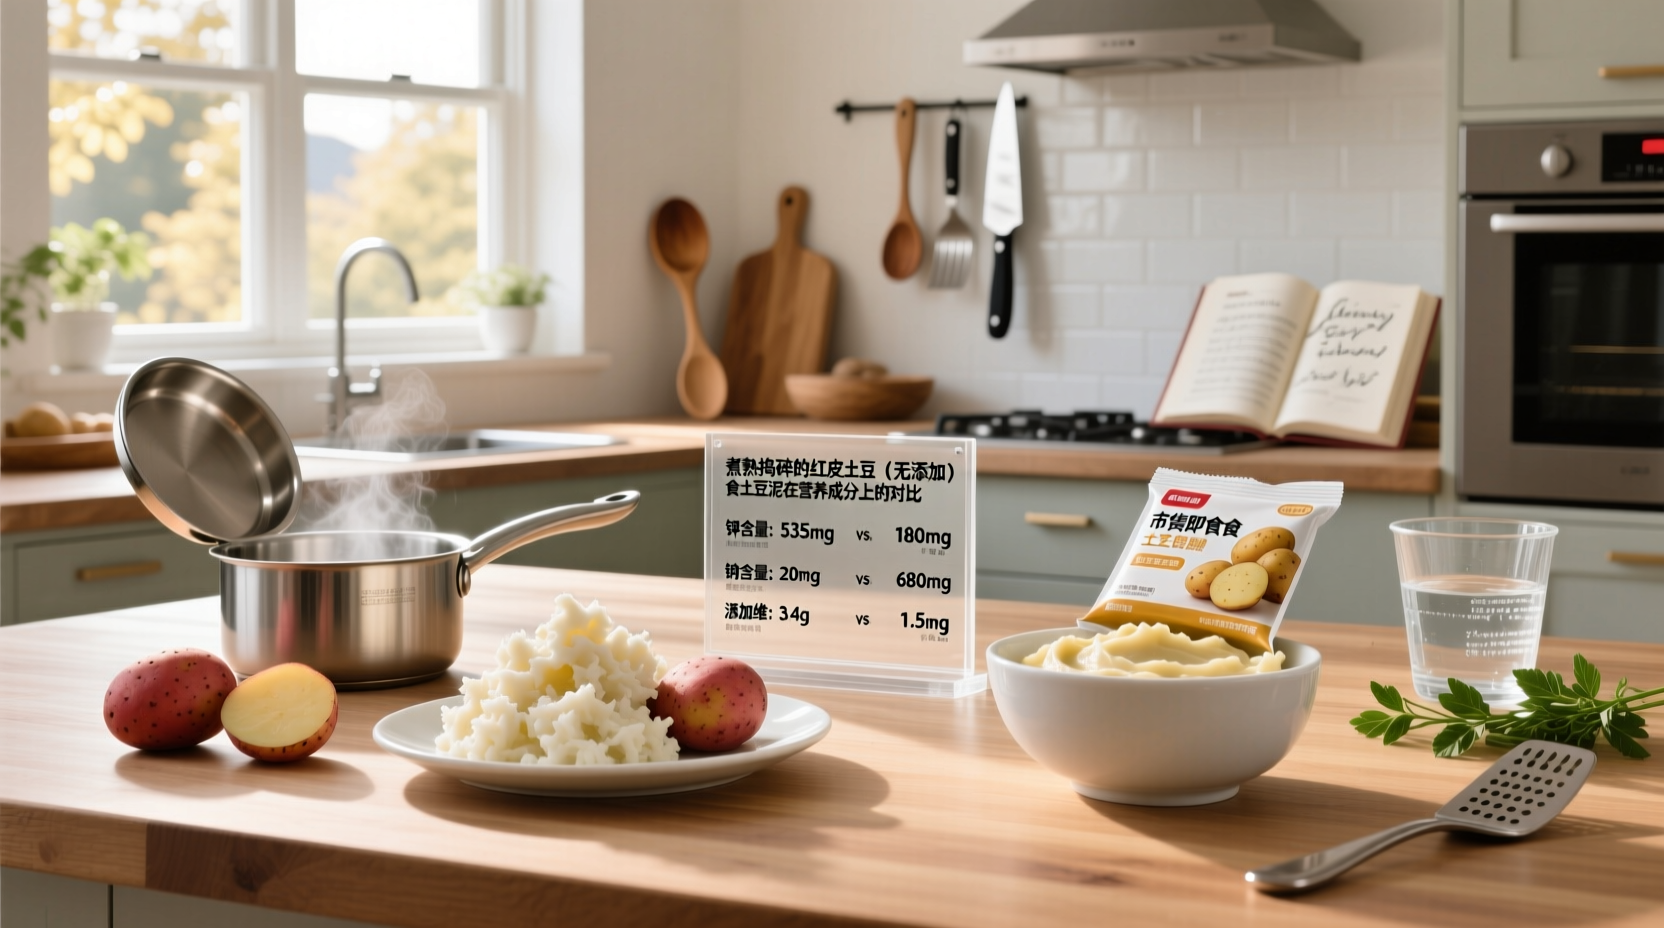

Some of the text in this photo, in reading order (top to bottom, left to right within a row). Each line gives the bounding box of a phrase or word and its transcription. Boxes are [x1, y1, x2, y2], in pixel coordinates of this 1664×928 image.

[726, 479, 922, 503] 食土豆泥在营养成分上的对比
[781, 522, 835, 545] 535mg
[896, 526, 951, 550] 180mg
[779, 566, 821, 587] 20mg
[896, 571, 951, 595] 680mg
[779, 605, 810, 626] 34g
[900, 611, 949, 636] 1.5mg
